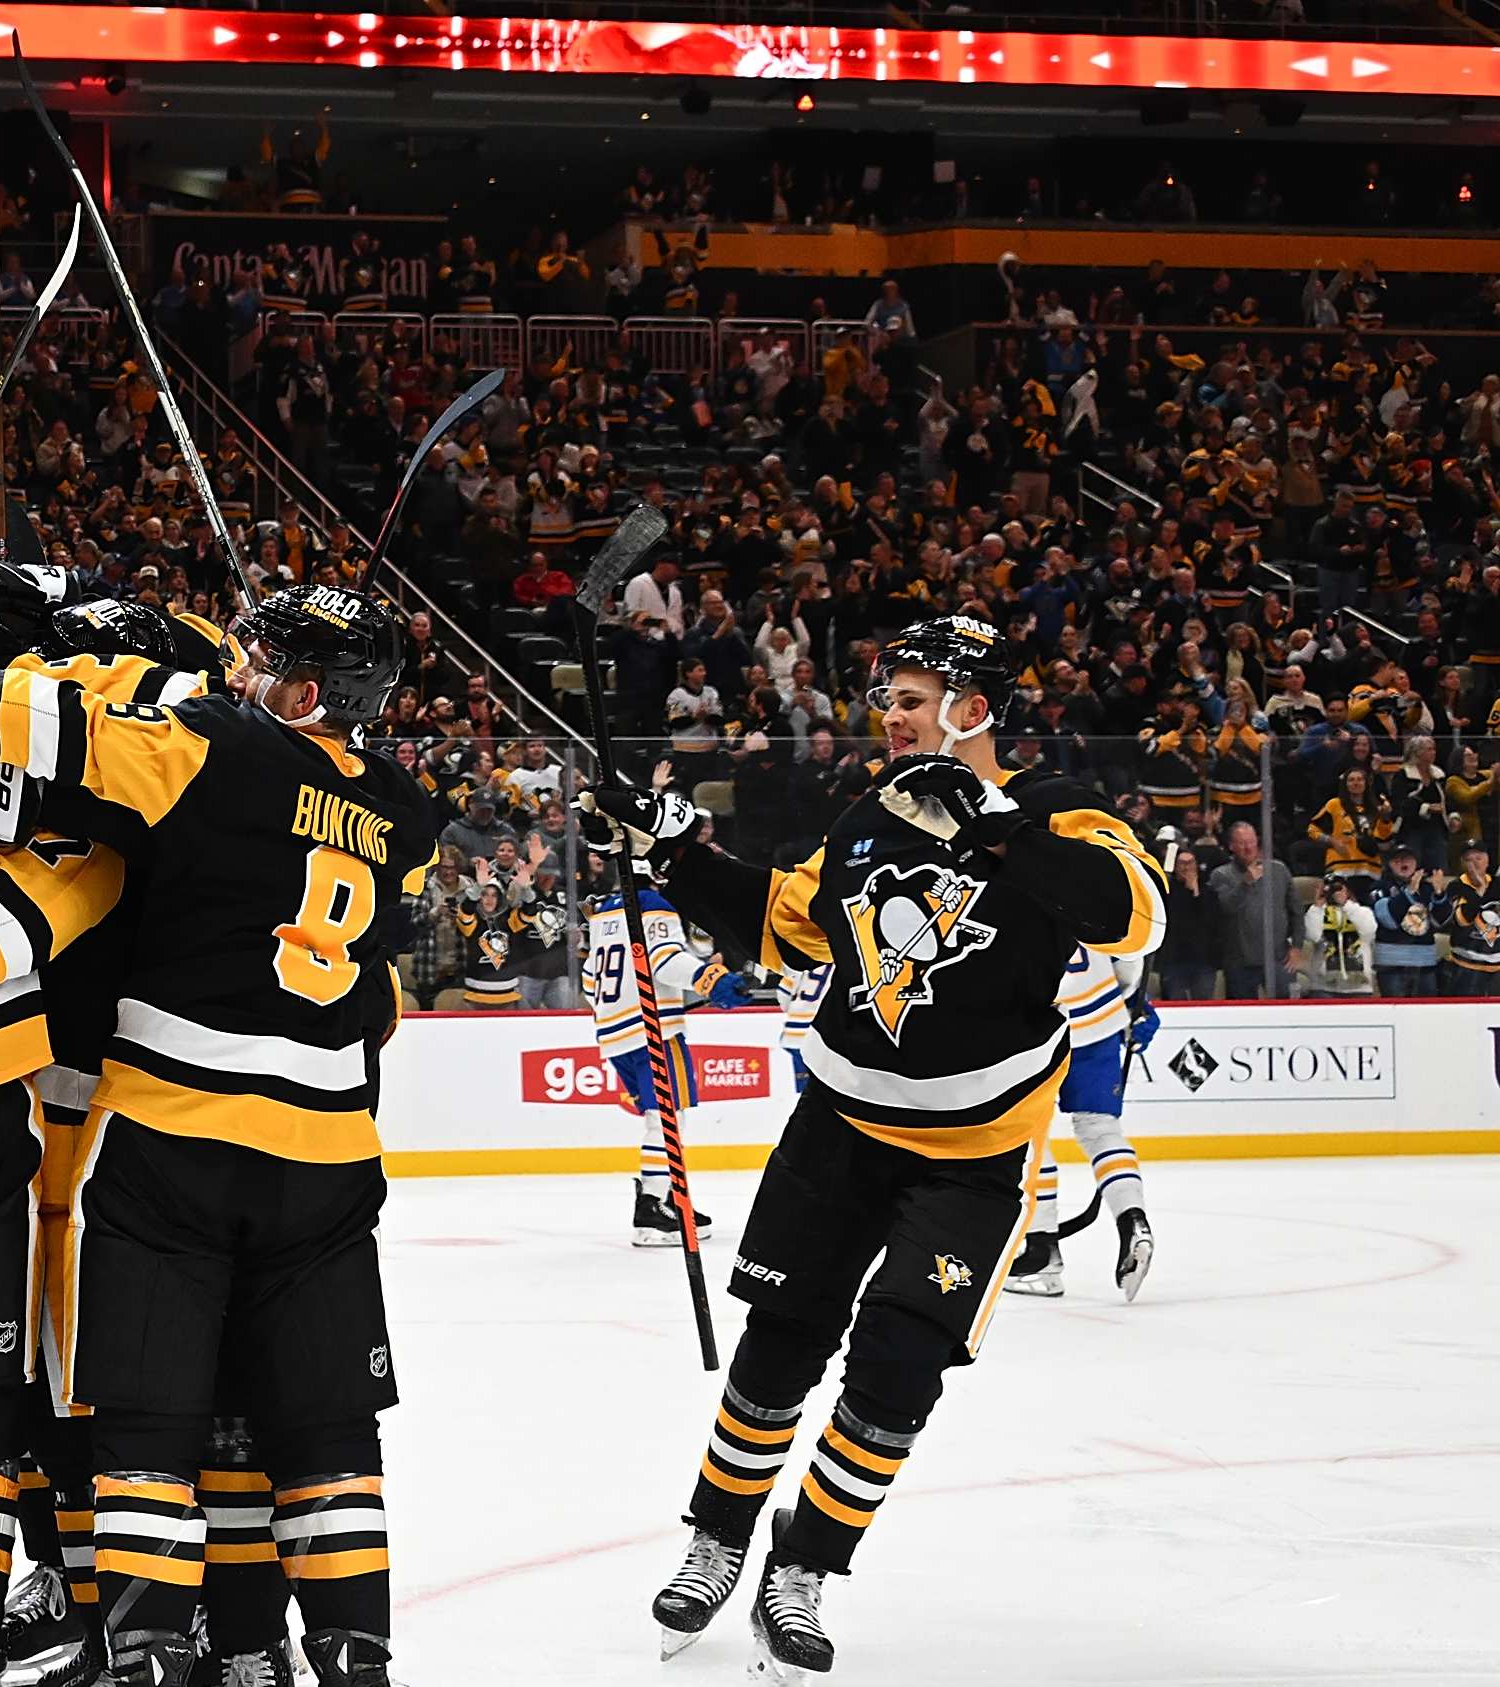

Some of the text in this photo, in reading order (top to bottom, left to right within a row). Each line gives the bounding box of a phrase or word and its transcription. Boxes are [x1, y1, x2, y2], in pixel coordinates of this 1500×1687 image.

[301, 602, 350, 630] PENGUIN
[308, 585, 362, 620] BOLD
[291, 785, 393, 865] BUNTING
[272, 844, 376, 1006] 8
[543, 1057, 618, 1100] get
[703, 1058, 746, 1074] CAFE
[703, 1072, 761, 1088] MARKET
[1228, 1045, 1382, 1083] STONE
